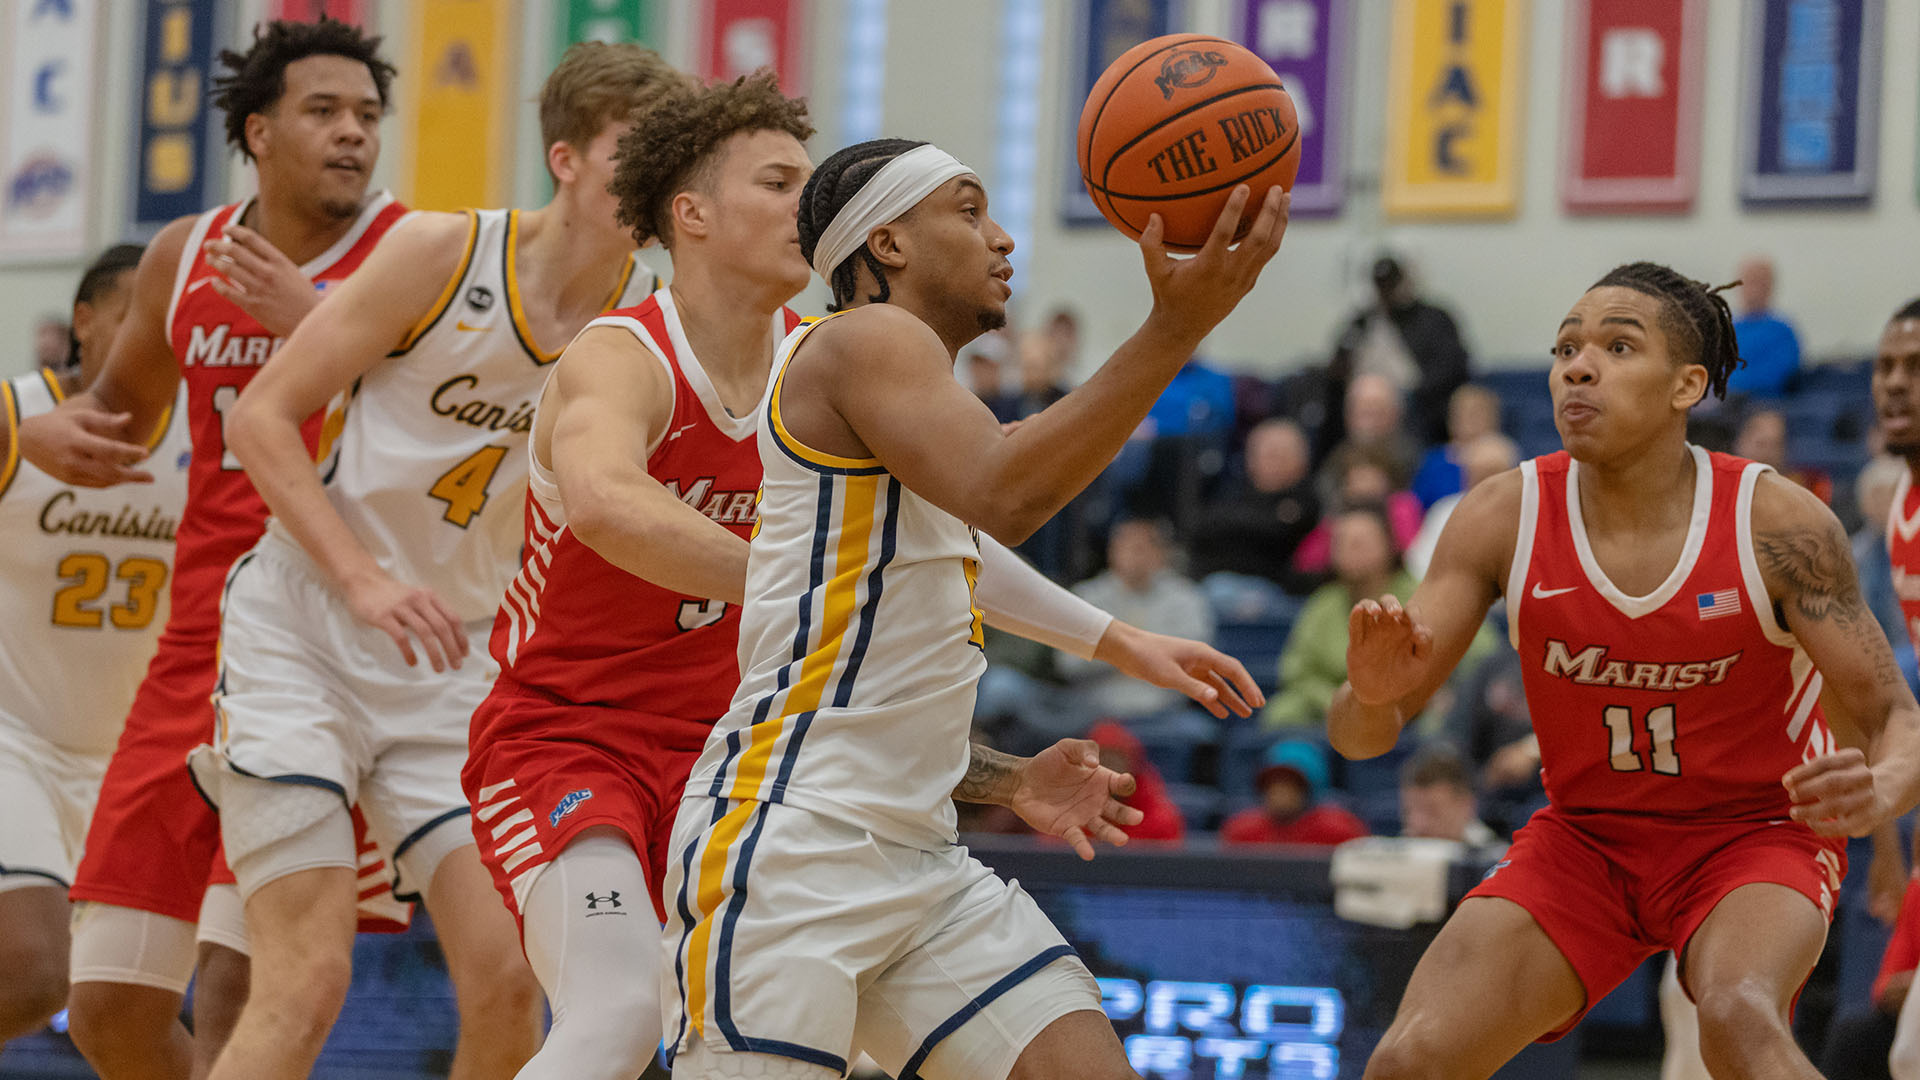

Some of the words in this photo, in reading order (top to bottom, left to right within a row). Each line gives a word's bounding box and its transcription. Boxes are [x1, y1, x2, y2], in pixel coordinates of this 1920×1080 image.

[1147, 127, 1219, 184] THE
[1217, 107, 1288, 164] ROCK
[426, 443, 511, 530] 4
[51, 551, 170, 631] 23
[1602, 703, 1682, 777] 11
[549, 788, 593, 828] MAAC
